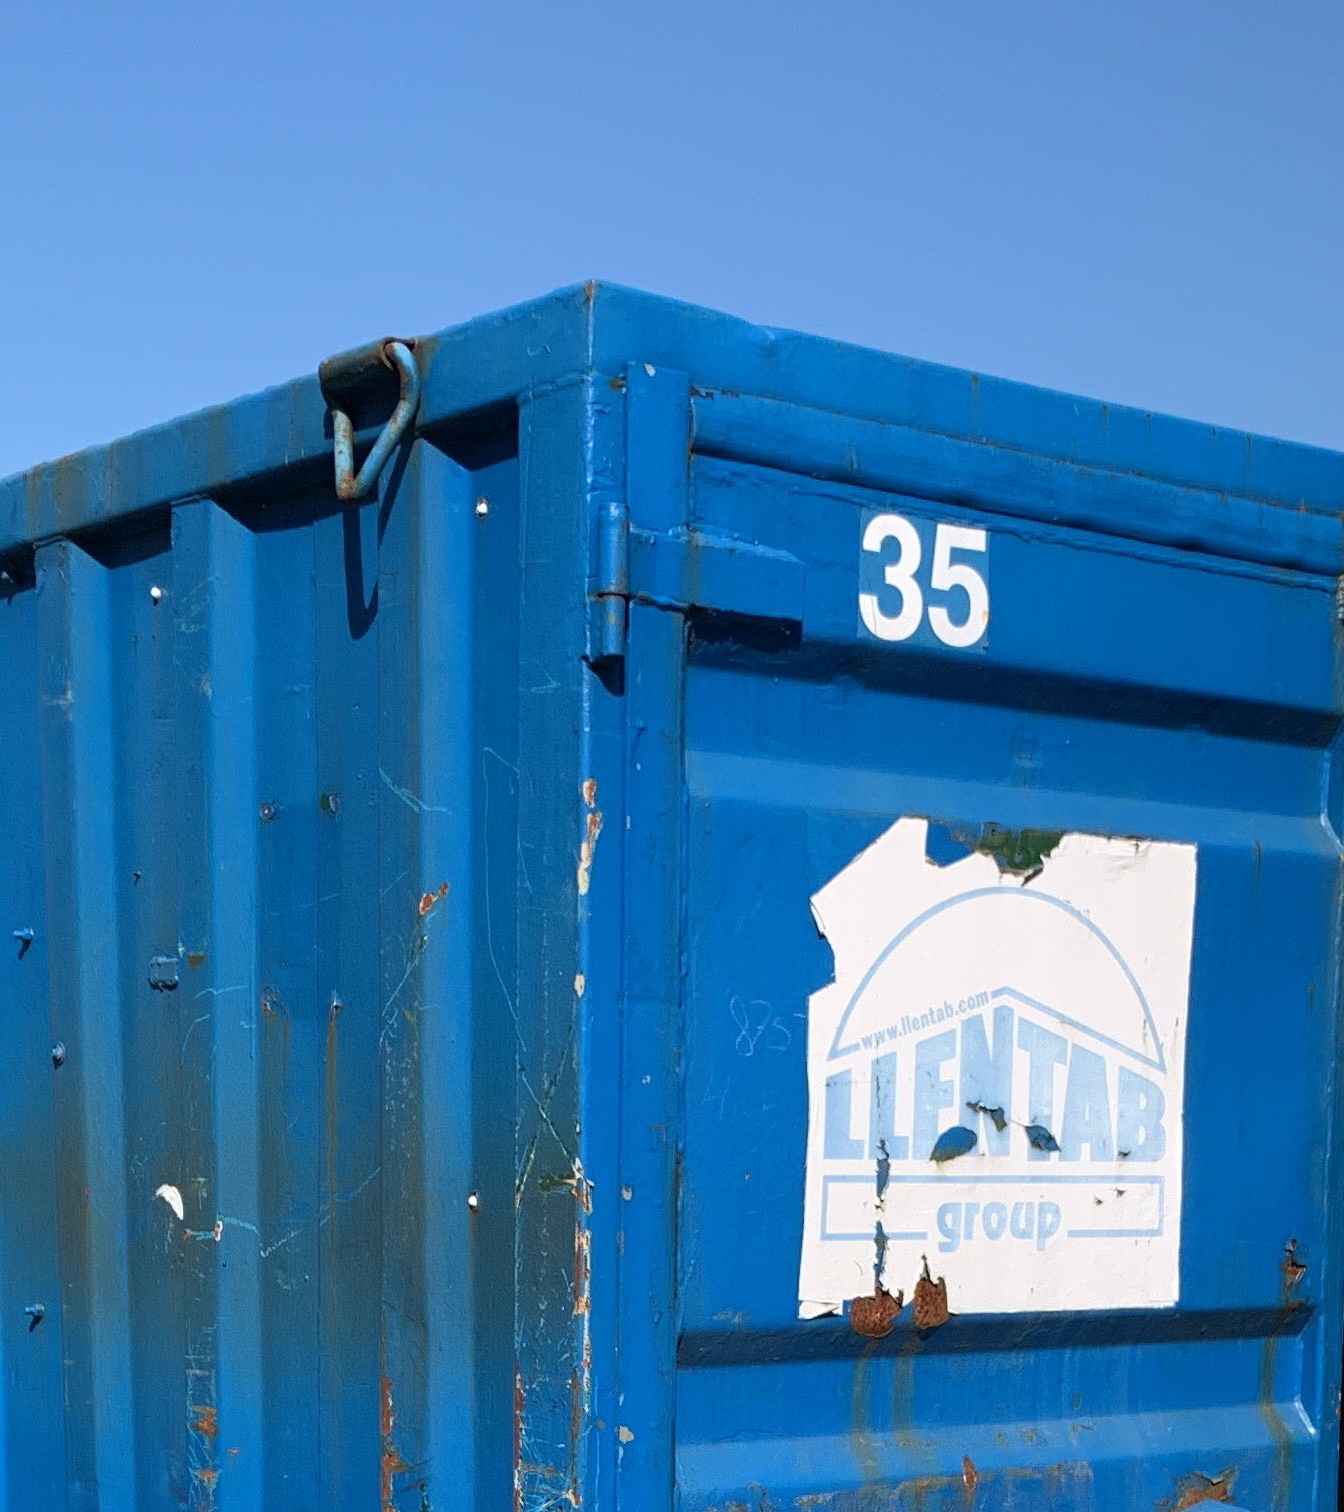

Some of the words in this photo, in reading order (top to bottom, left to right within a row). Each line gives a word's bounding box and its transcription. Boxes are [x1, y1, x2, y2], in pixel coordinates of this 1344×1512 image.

[859, 514, 989, 648] 35
[860, 990, 990, 1050] www.llentab.com
[823, 1004, 1167, 1162] LLENTAB
[937, 1201, 1063, 1253] group
